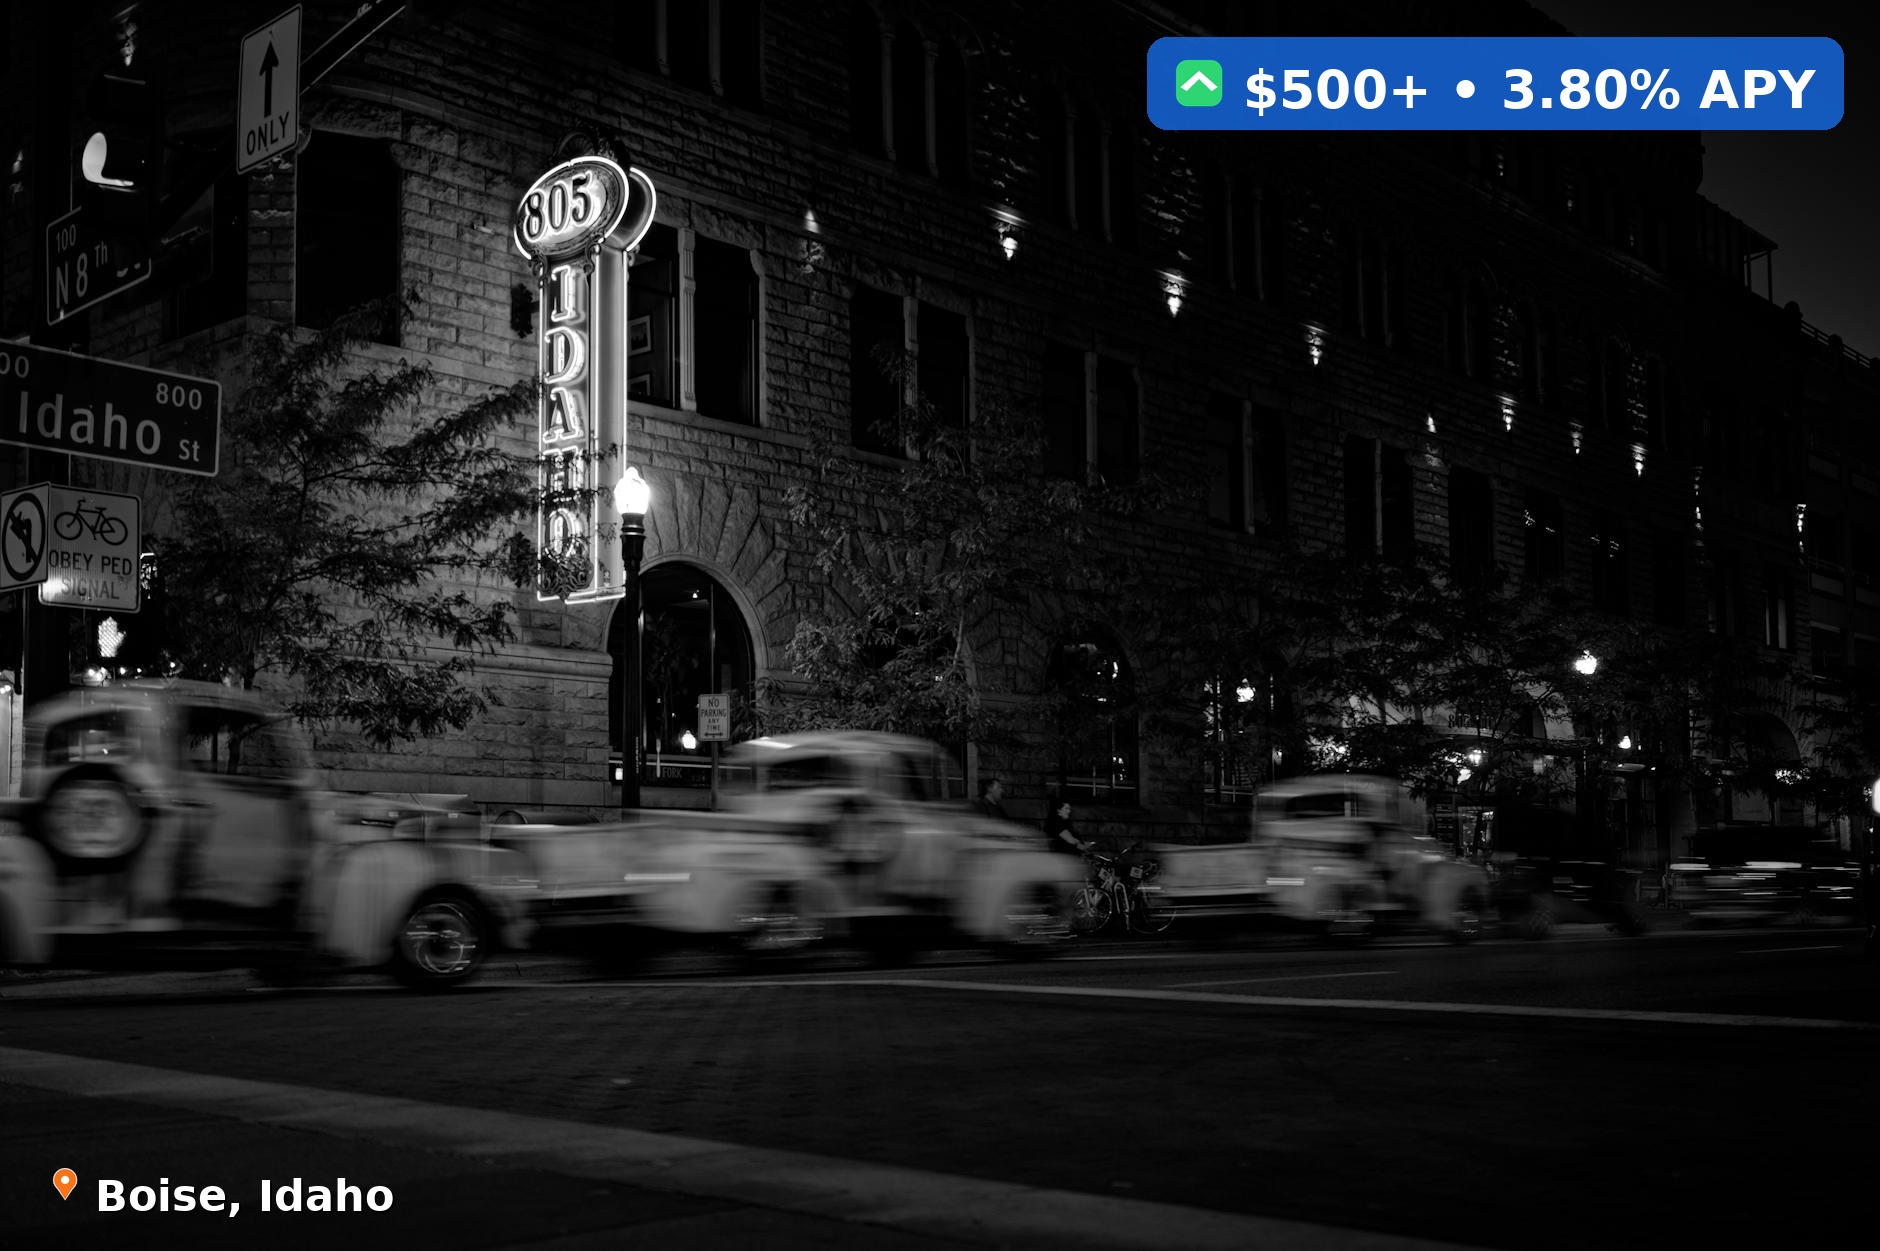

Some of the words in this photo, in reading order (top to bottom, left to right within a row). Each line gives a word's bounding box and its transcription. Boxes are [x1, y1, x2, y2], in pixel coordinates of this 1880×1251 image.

[246, 111, 290, 156] ONLY
[522, 169, 593, 244] 805
[56, 223, 77, 254] 100
[55, 260, 69, 310] N
[155, 381, 203, 411] 800
[18, 390, 161, 455] Idaho
[542, 264, 586, 562] IDAHO
[49, 549, 93, 572] OBEY
[101, 555, 132, 576] PED
[61, 576, 120, 600] SIGNAL
[700, 708, 727, 718] PARKING
[708, 698, 720, 708] NO
[662, 767, 683, 779] FORK
